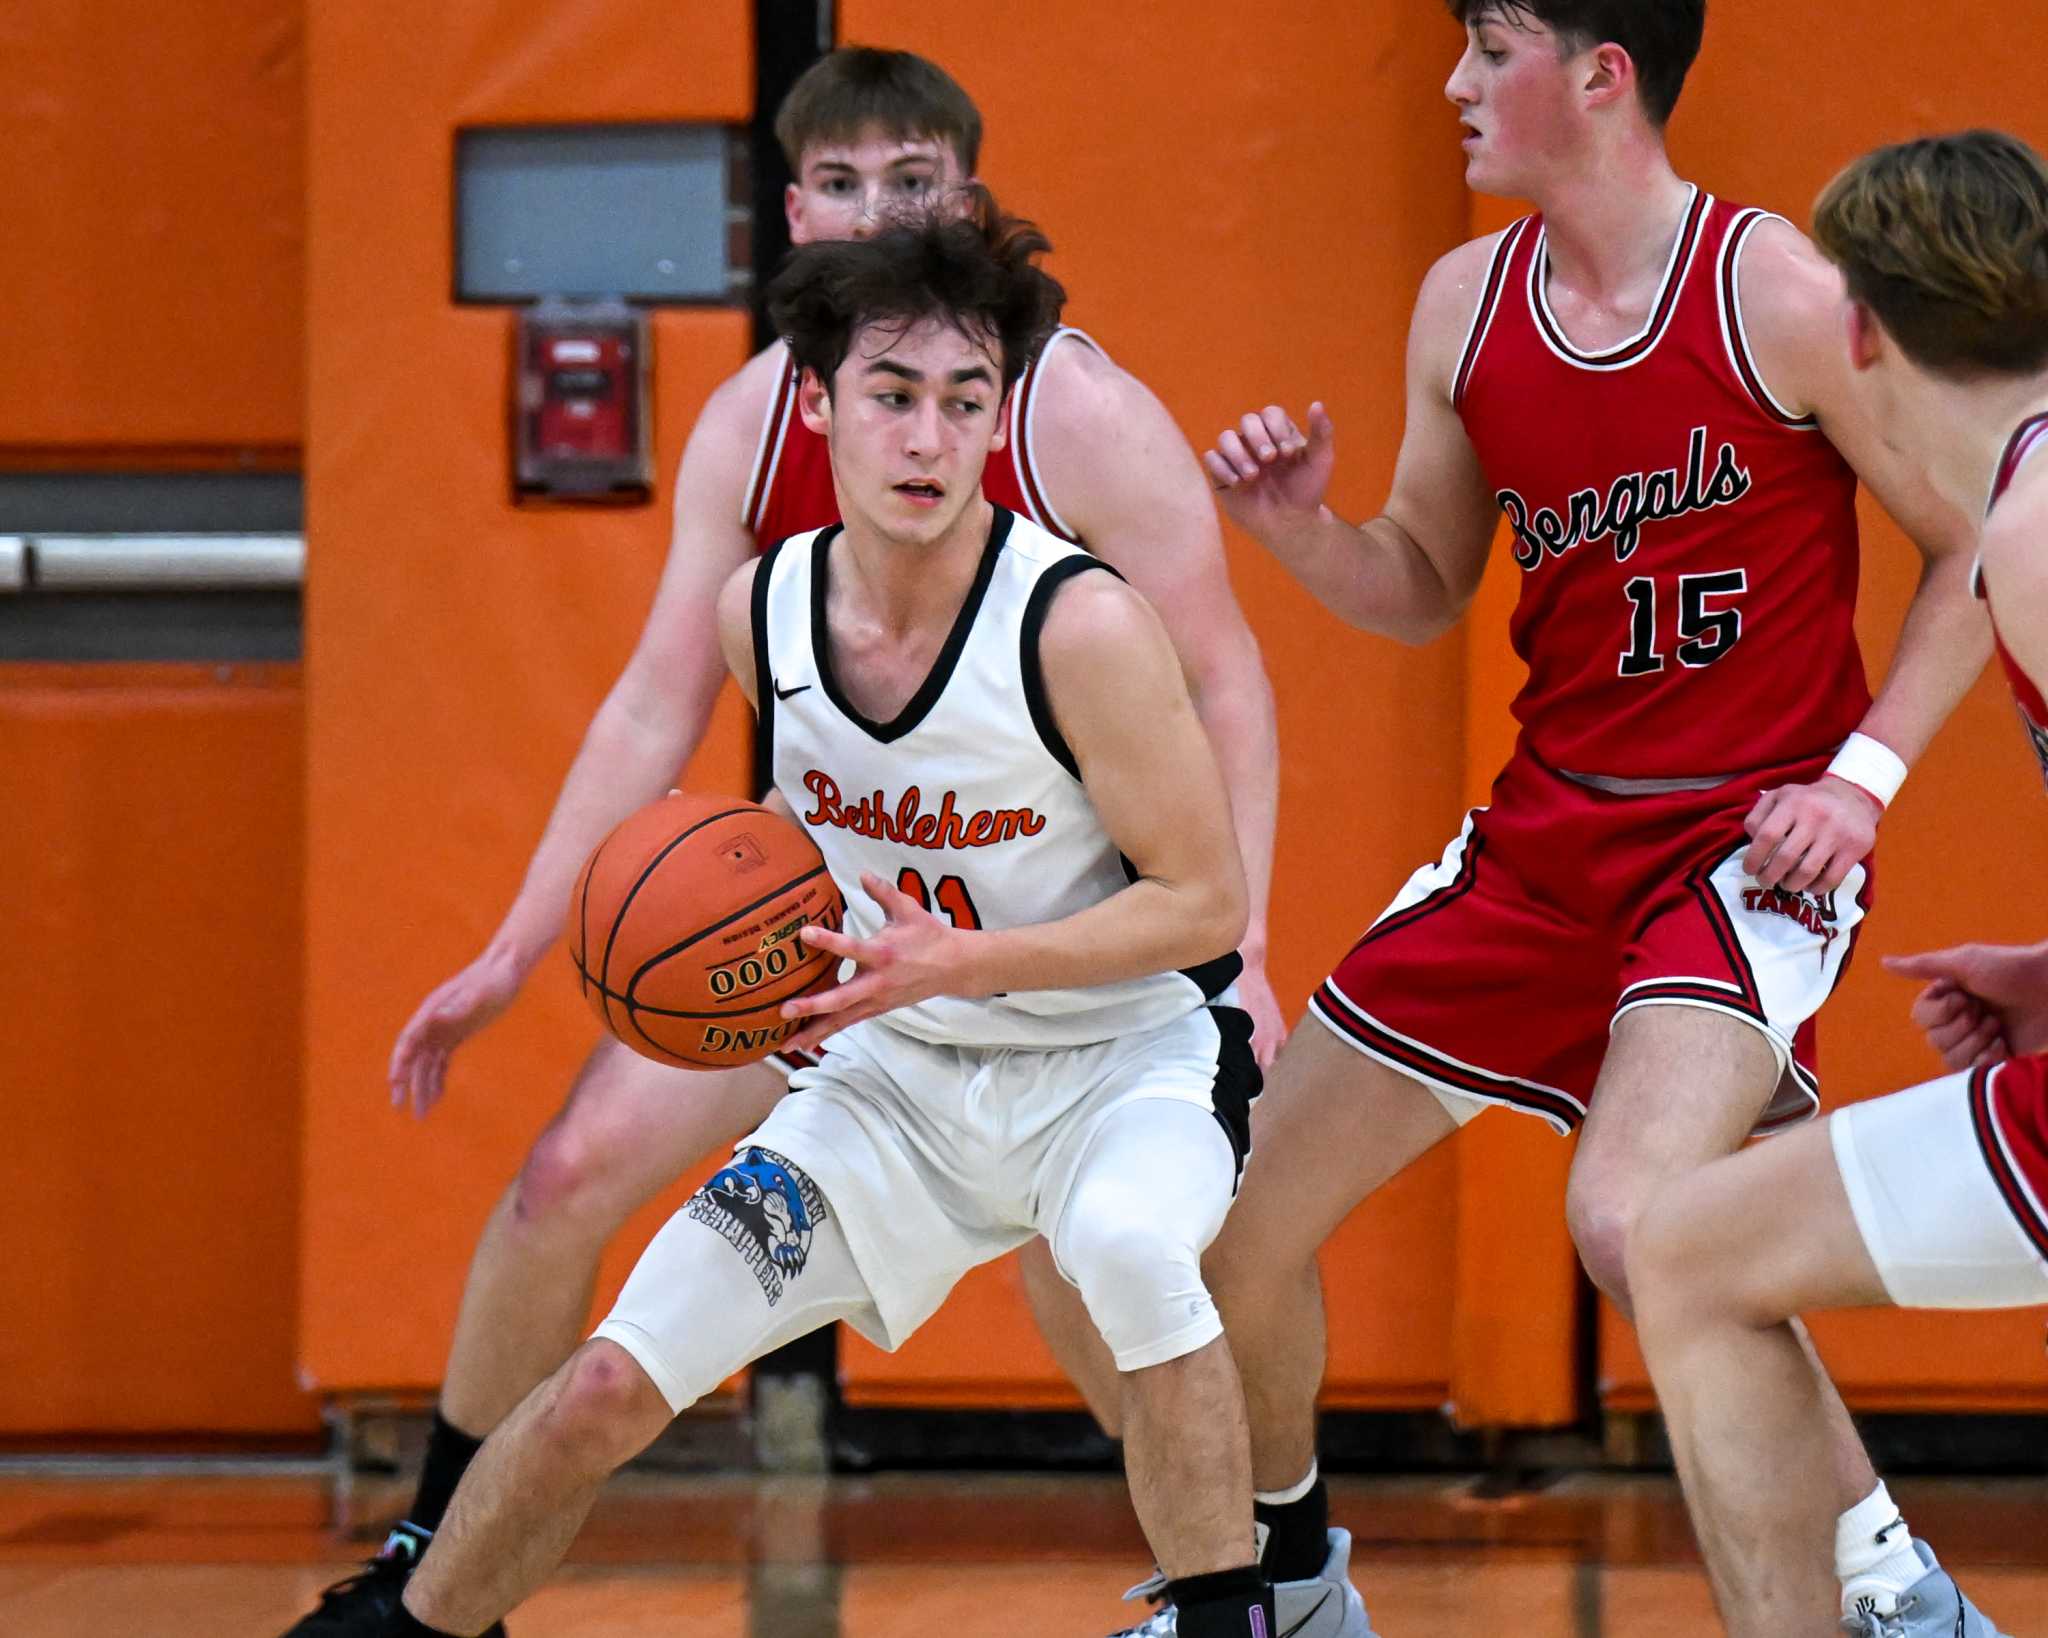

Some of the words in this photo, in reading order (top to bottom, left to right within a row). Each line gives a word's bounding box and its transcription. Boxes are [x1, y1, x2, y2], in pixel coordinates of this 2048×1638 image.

[1496, 425, 1752, 572] Bengals
[1617, 568, 1748, 677] 15
[803, 769, 1046, 849] Bethlehem
[709, 937, 808, 995] 1000
[759, 914, 809, 952] LEGACY
